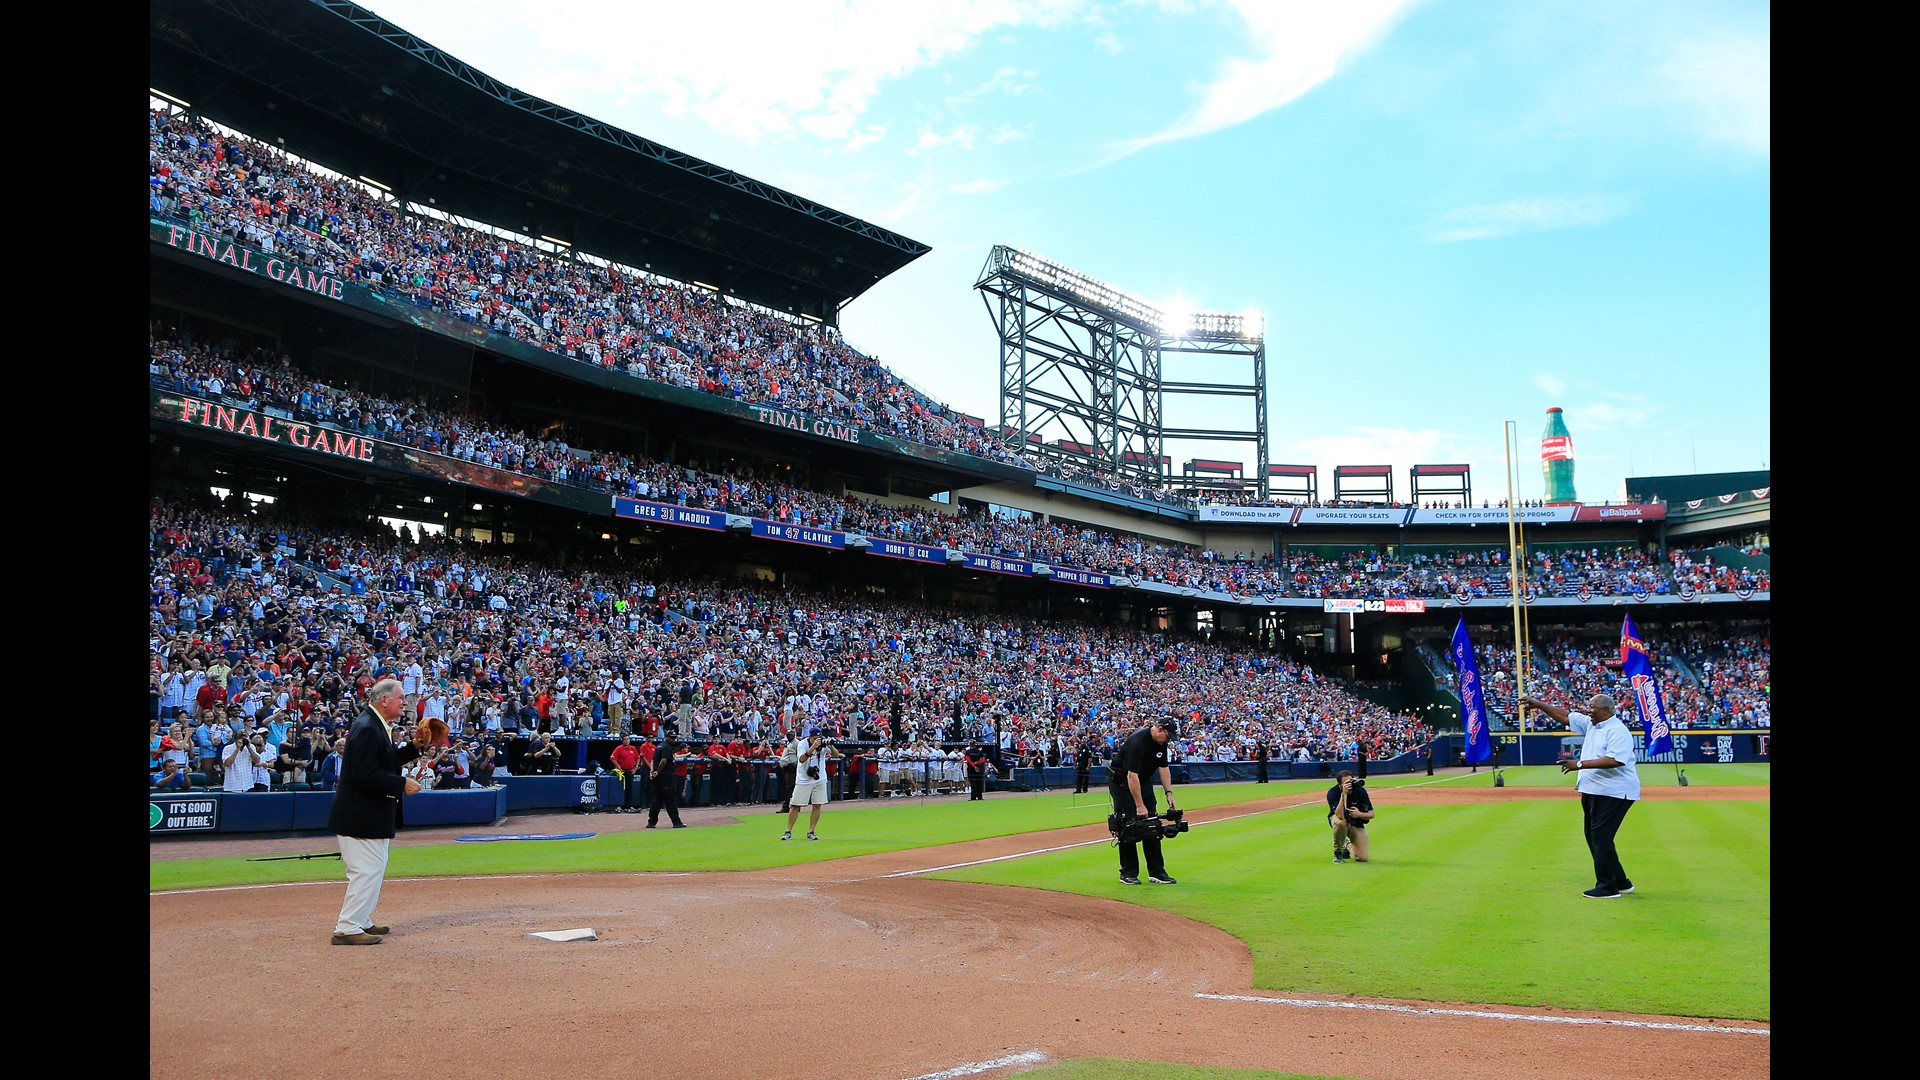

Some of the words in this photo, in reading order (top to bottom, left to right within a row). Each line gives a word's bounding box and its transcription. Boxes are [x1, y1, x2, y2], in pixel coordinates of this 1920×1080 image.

[168, 225, 257, 272] FINAL
[266, 259, 344, 300] GAME
[180, 398, 280, 442] FINAL
[290, 424, 375, 463] GAME
[759, 408, 809, 432] FINAL
[813, 420, 860, 444] GAME
[634, 504, 656, 517] GREG
[660, 507, 675, 521] 31
[679, 511, 711, 525] MADDUX
[1220, 510, 1256, 518] DOWNLOAD
[1609, 508, 1642, 518] Ballpark
[767, 525, 781, 536] TOM
[785, 526, 800, 540] 47
[803, 531, 833, 544] GLAVINE
[885, 544, 905, 555] BOBBY
[917, 549, 929, 558] COX
[974, 558, 988, 567] JOHN
[990, 558, 1001, 571] 29
[1003, 562, 1024, 573] SMOLTZ
[1057, 571, 1077, 581] CHIPPER
[1079, 573, 1088, 584] 10
[1089, 576, 1104, 585] JONES
[1335, 600, 1357, 608] ARROW
[1717, 740, 1732, 748] DAY
[1718, 753, 1734, 762] 2017
[169, 802, 187, 814] IT'S
[188, 802, 213, 813] GOOD
[167, 816, 186, 828] OUT
